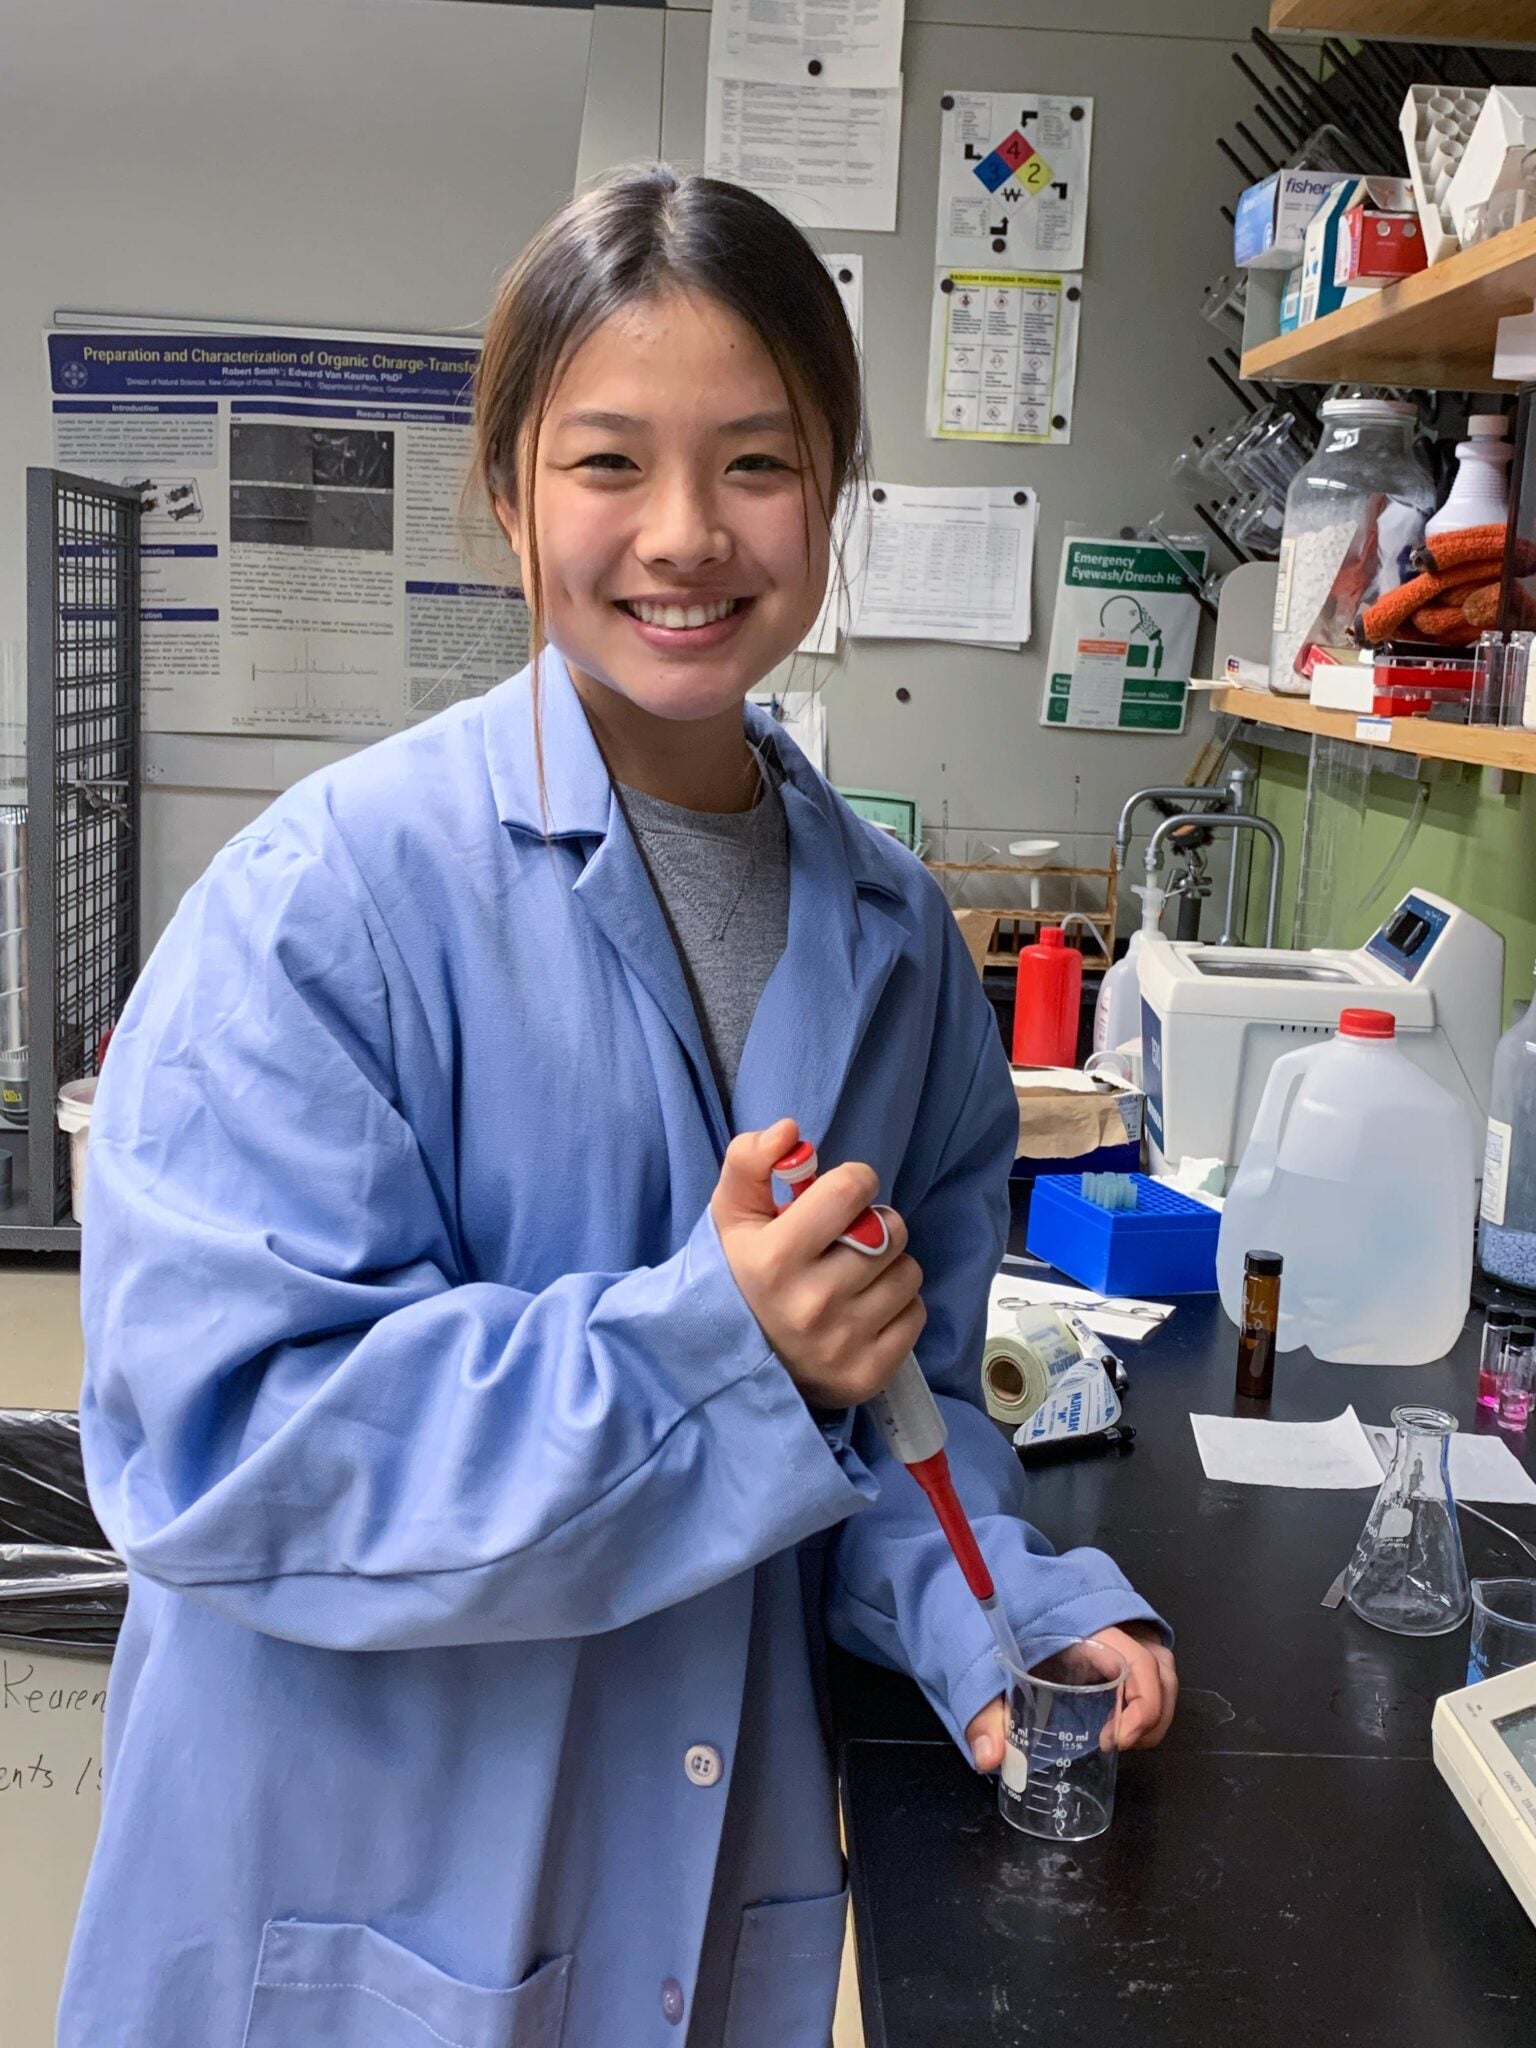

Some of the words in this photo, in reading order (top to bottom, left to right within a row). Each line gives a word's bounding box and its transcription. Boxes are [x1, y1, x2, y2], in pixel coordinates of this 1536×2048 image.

[1006, 141, 1021, 160] 4
[988, 163, 1000, 183] 3
[1027, 163, 1041, 184] 2
[84, 346, 160, 365] Preparation
[164, 349, 190, 362] and
[191, 349, 297, 364] Characterization
[301, 352, 314, 365] of
[317, 351, 368, 371] Organic
[222, 367, 251, 376] Robert
[288, 368, 323, 378] Edward
[325, 370, 342, 379] Van
[112, 404, 159, 413] Introduction
[356, 410, 385, 419] Results
[387, 411, 401, 420] and
[140, 548, 175, 556] uestions
[1073, 551, 1136, 568] Emergency
[1072, 566, 1164, 585] Eyewash/Drench
[140, 612, 163, 620] ration
[1058, 1731, 1074, 1742] 80
[1075, 1731, 1089, 1742] ml
[1055, 1758, 1072, 1768] 60
